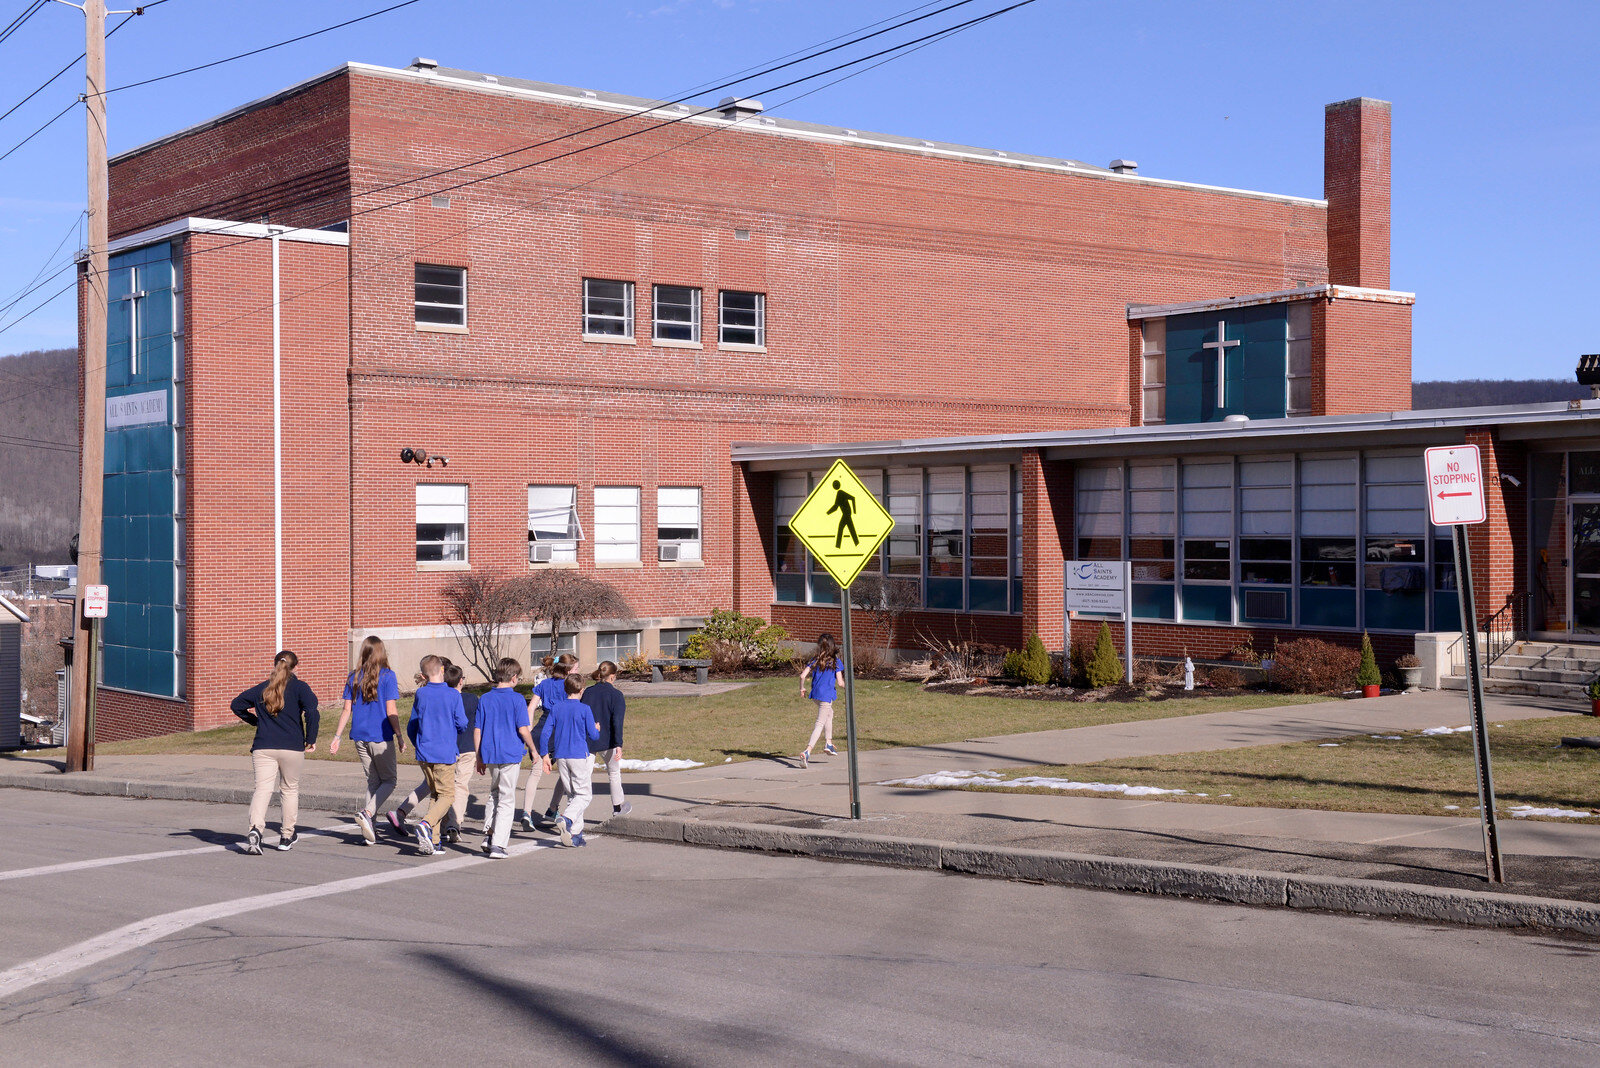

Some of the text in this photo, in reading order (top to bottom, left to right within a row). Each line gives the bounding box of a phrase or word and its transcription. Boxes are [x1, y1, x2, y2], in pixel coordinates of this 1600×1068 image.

[109, 404, 118, 418] ALL
[120, 401, 138, 416] SAINTS
[1446, 462, 1460, 472] NO
[1578, 466, 1595, 475] ALL
[1433, 472, 1476, 485] STOPPING
